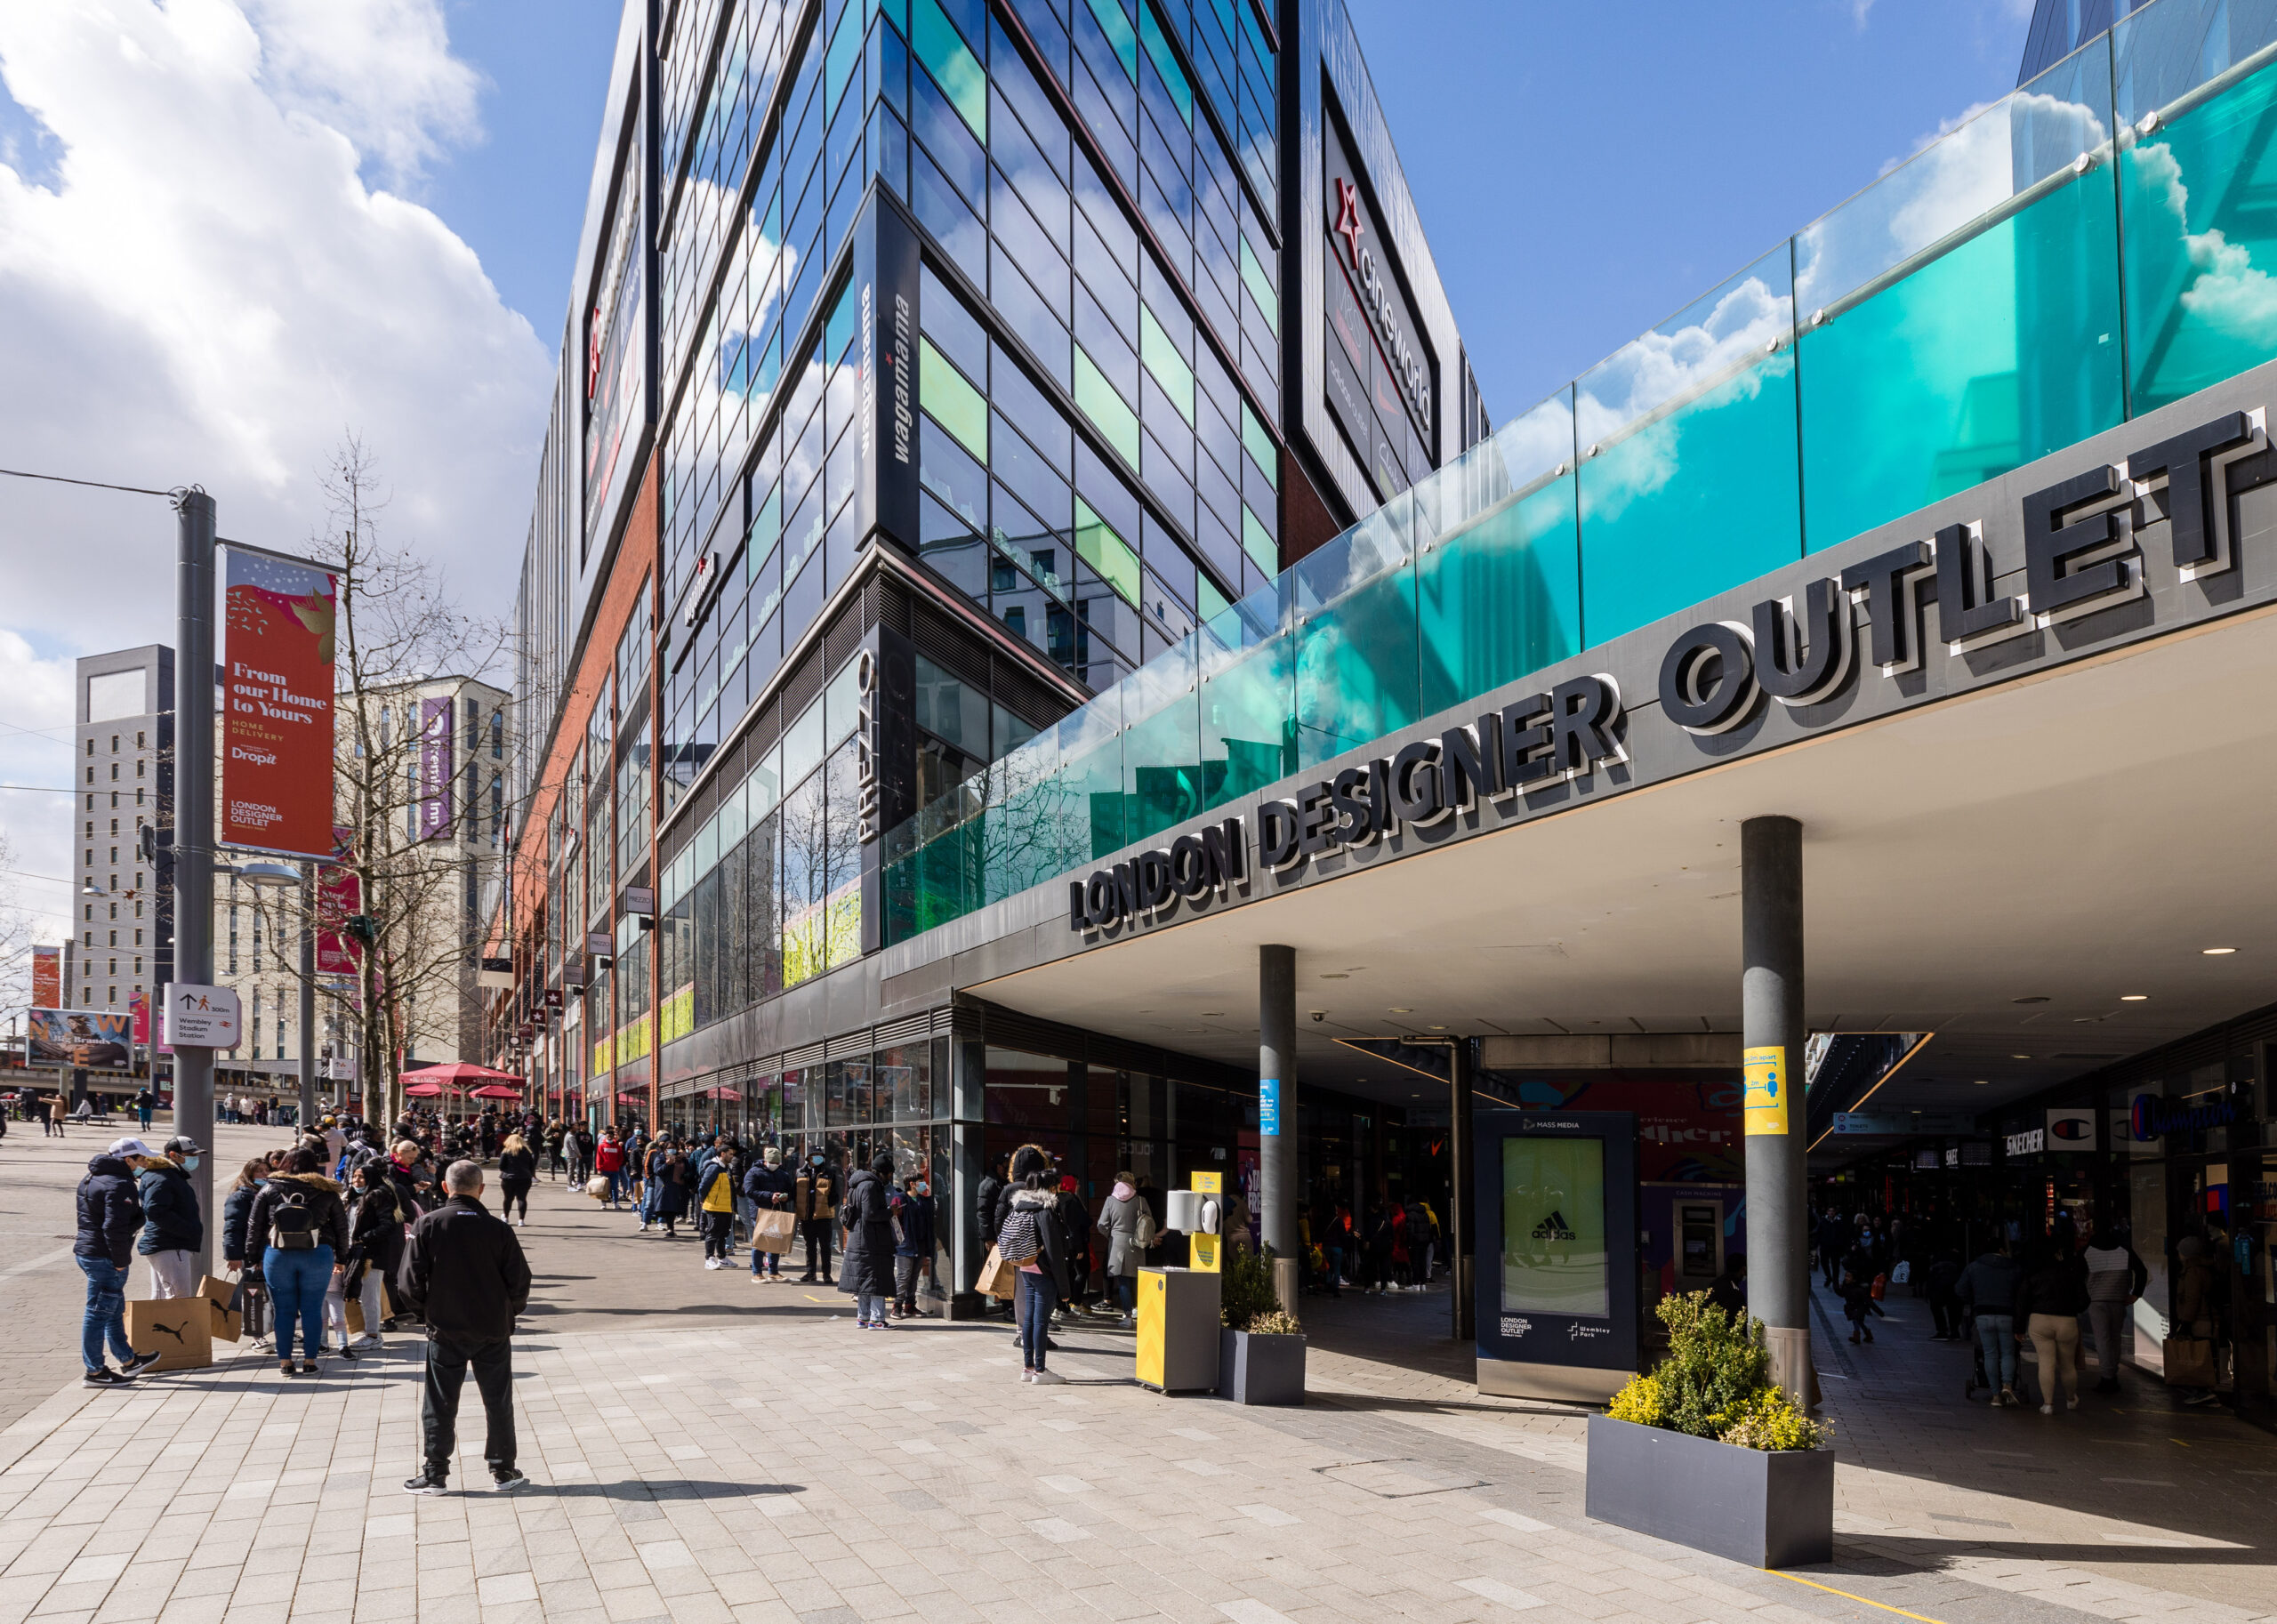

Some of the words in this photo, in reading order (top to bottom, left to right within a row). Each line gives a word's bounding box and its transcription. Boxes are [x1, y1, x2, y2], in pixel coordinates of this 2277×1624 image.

[1358, 246, 1431, 431] cineworld
[895, 293, 913, 464] wagamama
[233, 662, 287, 686] From
[1070, 816, 1245, 935] LONDON
[1259, 673, 1629, 872] DESIGNER
[1659, 406, 2266, 736] OUTLET
[233, 684, 269, 699] our
[272, 687, 327, 710] Home
[233, 698, 253, 712] to
[258, 701, 313, 724] Yours
[232, 720, 264, 731] HOME
[232, 727, 284, 742] DELIVERY
[857, 647, 879, 845] PREZZO
[232, 747, 278, 765] Dropit
[231, 800, 276, 813] LONDON
[231, 808, 283, 822] DESIGNER
[430, 802, 442, 825] Inn
[230, 816, 269, 827] OUTLET
[629, 896, 651, 904] PREZZO
[179, 1017, 212, 1025] Wembley
[74, 1035, 110, 1045] Brands
[1639, 1125, 1732, 1143] ther
[2005, 1129, 2044, 1156] SKECHER
[1532, 1229, 1576, 1241] adidas
[1580, 1326, 1610, 1334] Wembley
